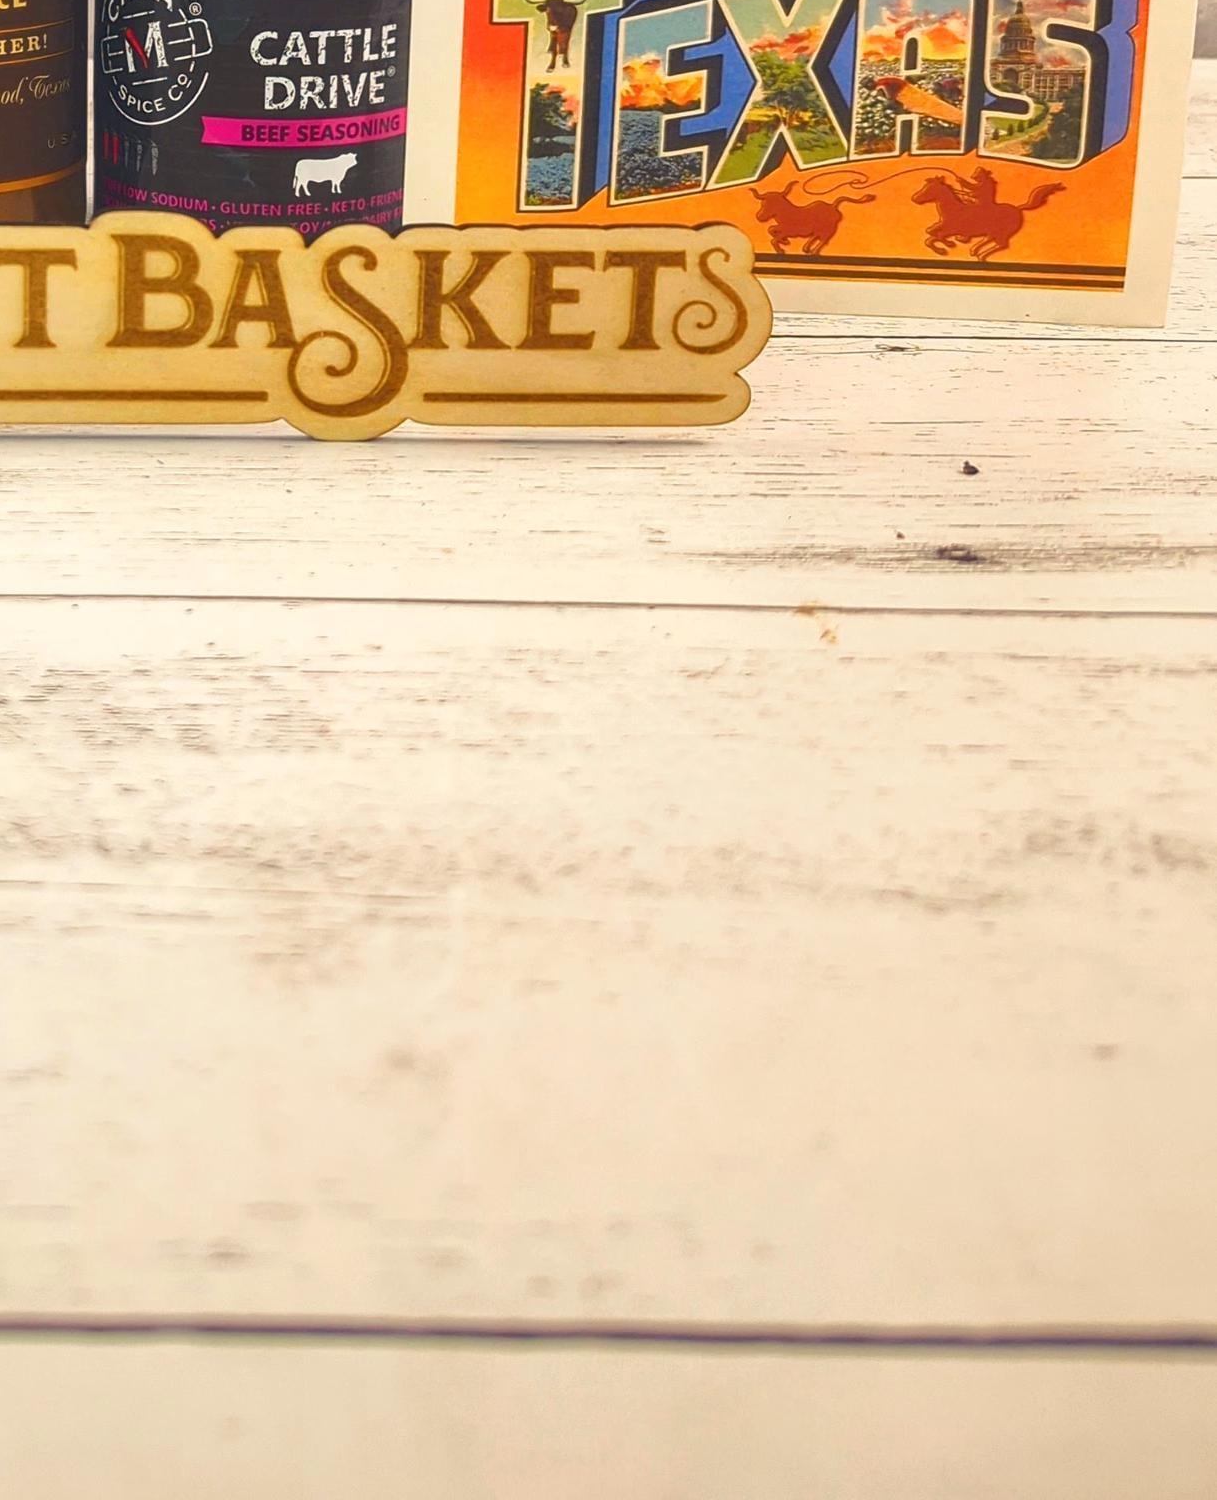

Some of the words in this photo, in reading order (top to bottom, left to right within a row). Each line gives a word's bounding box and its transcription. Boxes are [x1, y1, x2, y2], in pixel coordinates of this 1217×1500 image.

[123, 21, 170, 73] M
[250, 23, 398, 66] CATTLE
[118, 84, 167, 114] SPICE
[264, 69, 386, 110] DRIVE
[241, 124, 290, 143] BEEF
[296, 114, 400, 142] SEASONING
[151, 192, 208, 211] SODIUM
[220, 201, 281, 217] GLUTEN
[287, 203, 322, 216] FREE
[106, 234, 749, 418] BASKETS
